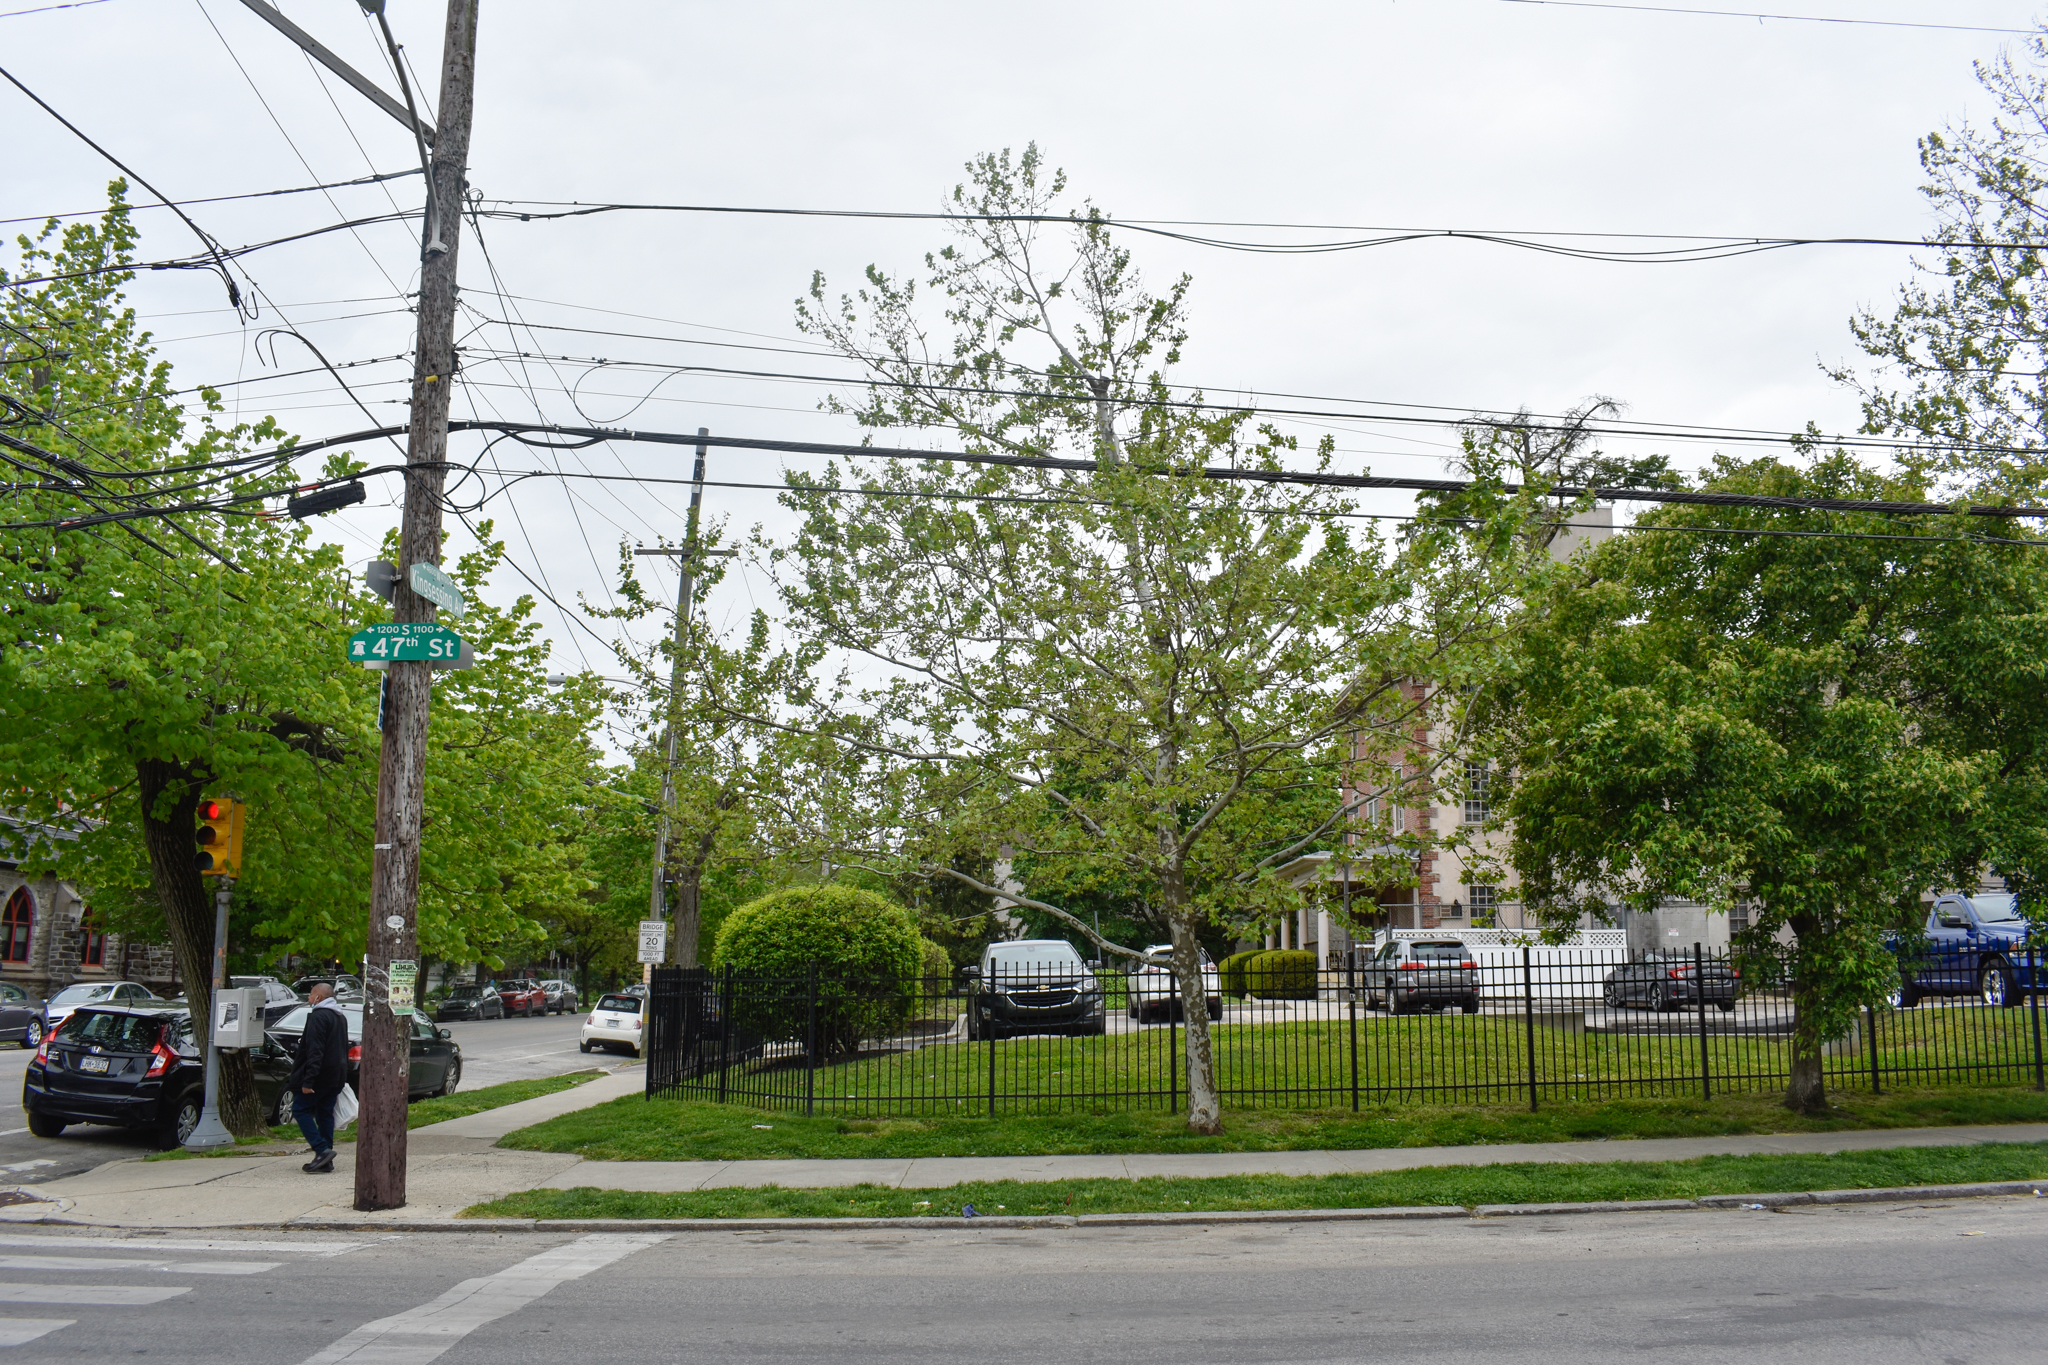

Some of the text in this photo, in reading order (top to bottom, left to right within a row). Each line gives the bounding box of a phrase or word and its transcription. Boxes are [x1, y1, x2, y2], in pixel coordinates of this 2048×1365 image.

[412, 568, 453, 612] Kingsessing
[377, 625, 434, 635] 1200 S 1100
[372, 637, 454, 657] 47th St
[646, 937, 658, 945] 20
